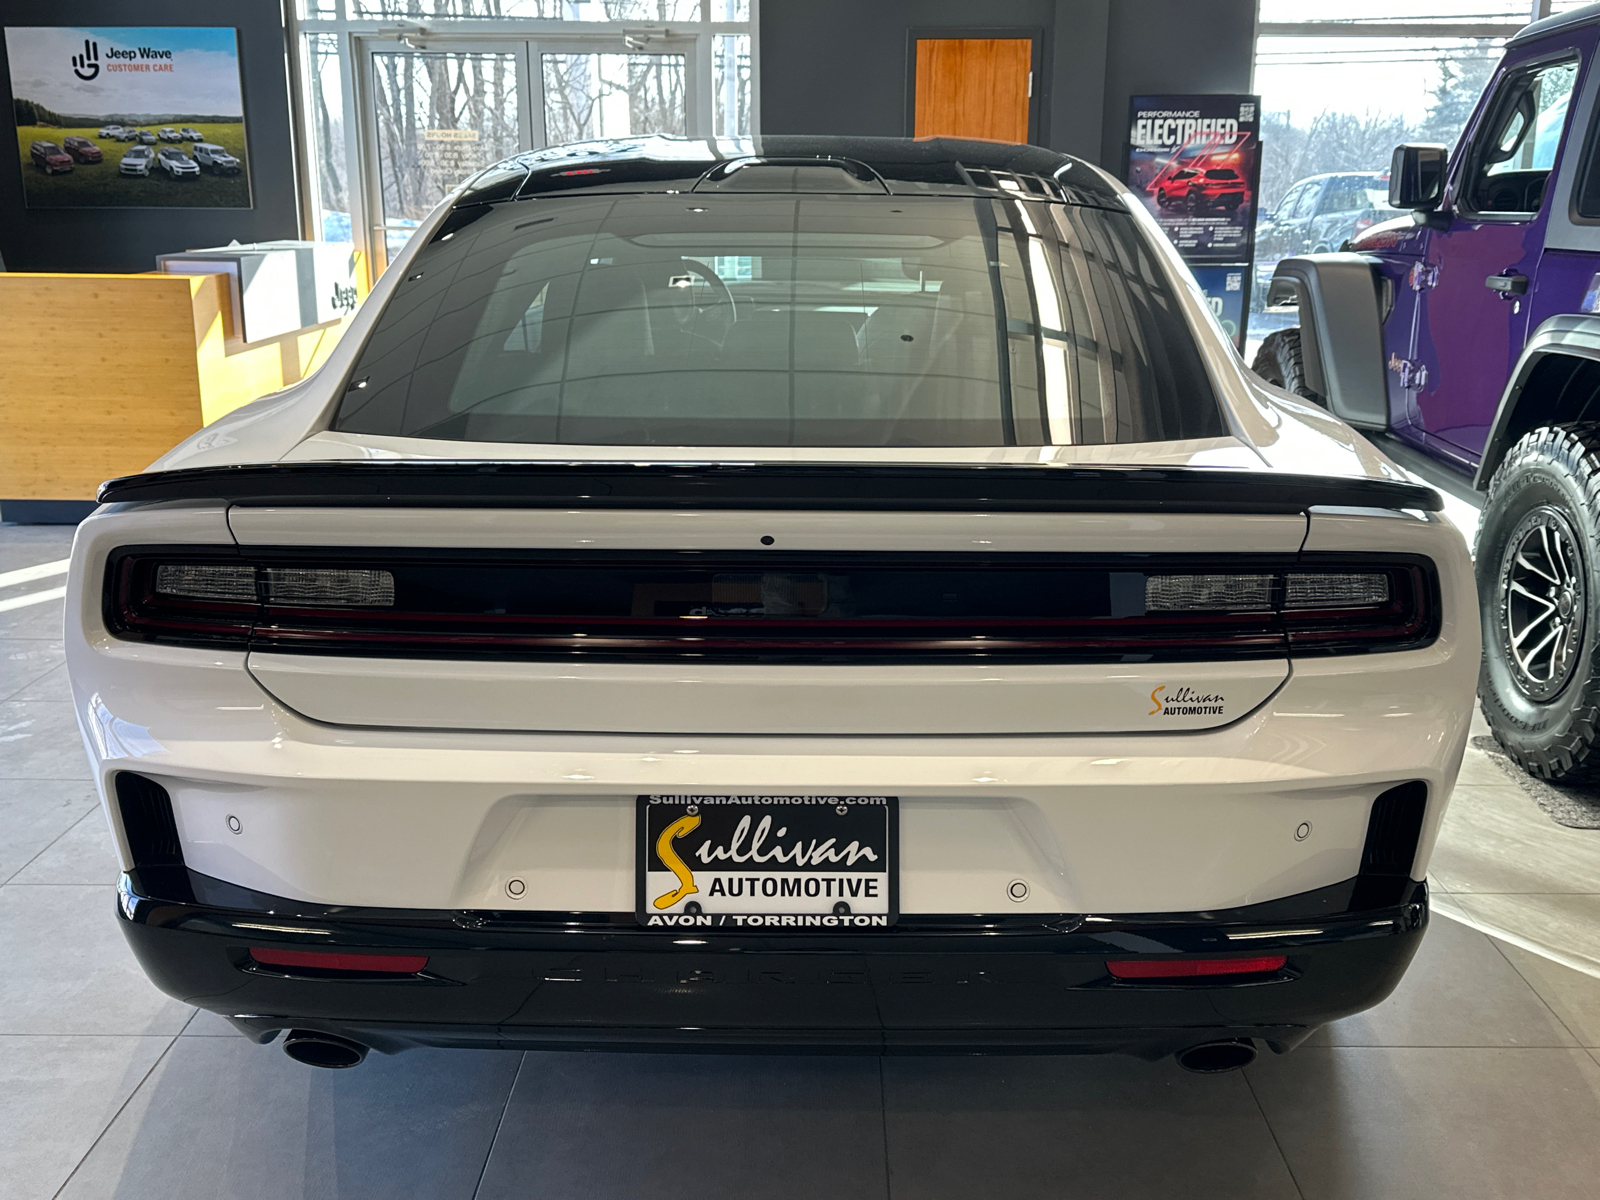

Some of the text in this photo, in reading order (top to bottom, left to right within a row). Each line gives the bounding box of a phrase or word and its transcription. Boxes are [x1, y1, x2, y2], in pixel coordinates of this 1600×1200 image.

[105, 47, 172, 61] Jeep Wave
[107, 64, 174, 72] CUSTOMER CARE
[1137, 110, 1201, 118] PERFORMANCE
[1136, 118, 1239, 145] ELECTRIFIED
[1148, 685, 1225, 715] Sullivan
[1163, 706, 1224, 715] AUTOMOTIVE
[648, 795, 887, 805] SullivanAutomotive.com
[653, 814, 879, 910] Sullivan
[708, 877, 879, 898] AUTOMOTIVE
[647, 915, 712, 927] AVON
[733, 915, 888, 927] TORRINGTON
